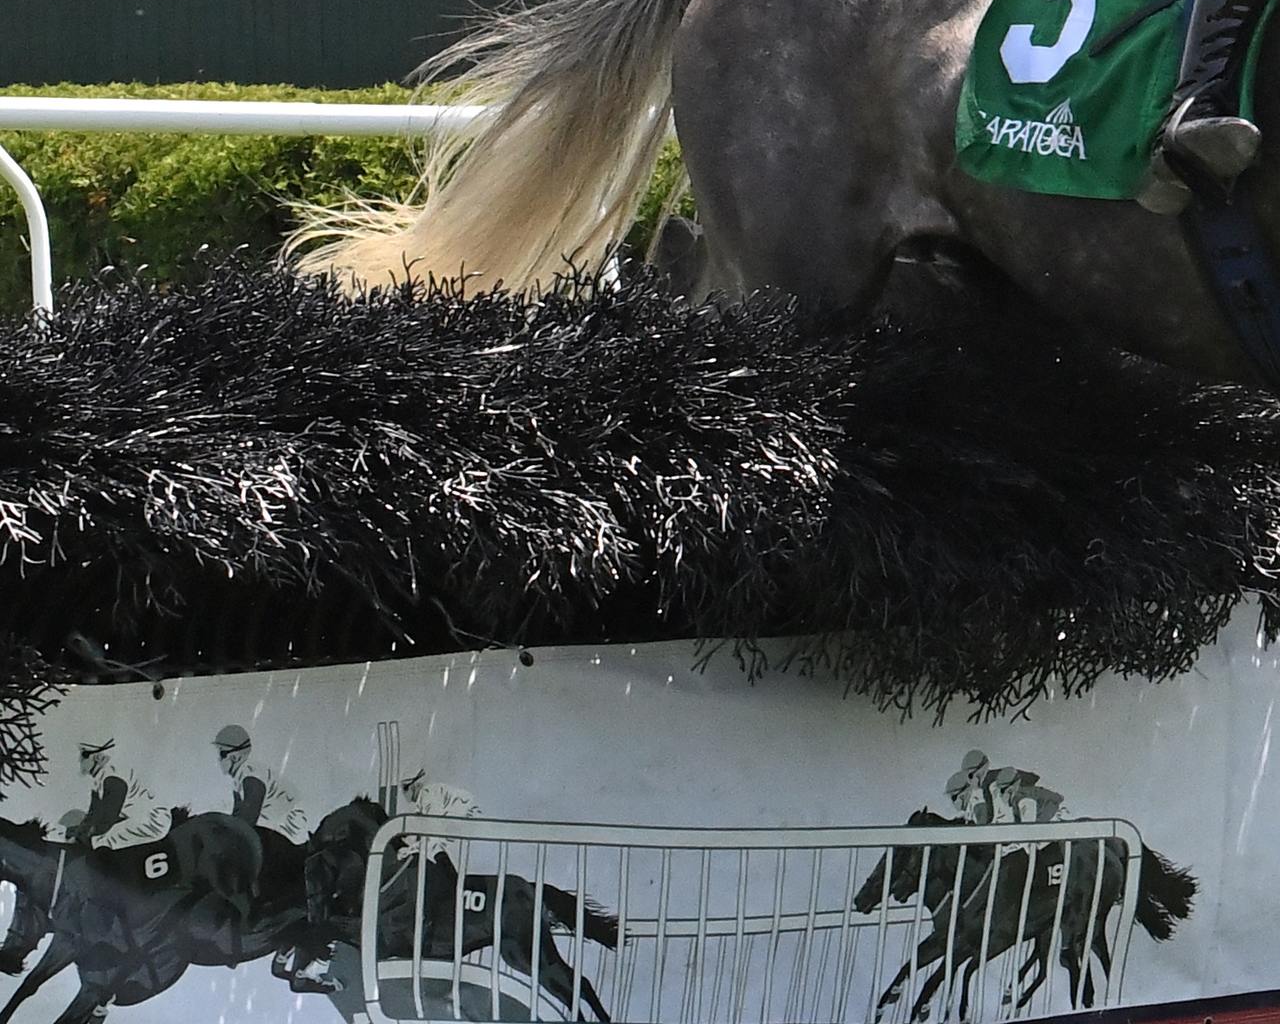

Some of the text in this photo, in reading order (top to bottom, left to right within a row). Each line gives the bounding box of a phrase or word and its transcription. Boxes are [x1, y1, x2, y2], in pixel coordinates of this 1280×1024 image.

[978, 110, 1087, 160] ARATOGA
[143, 852, 169, 879] 6
[463, 889, 487, 913] 10
